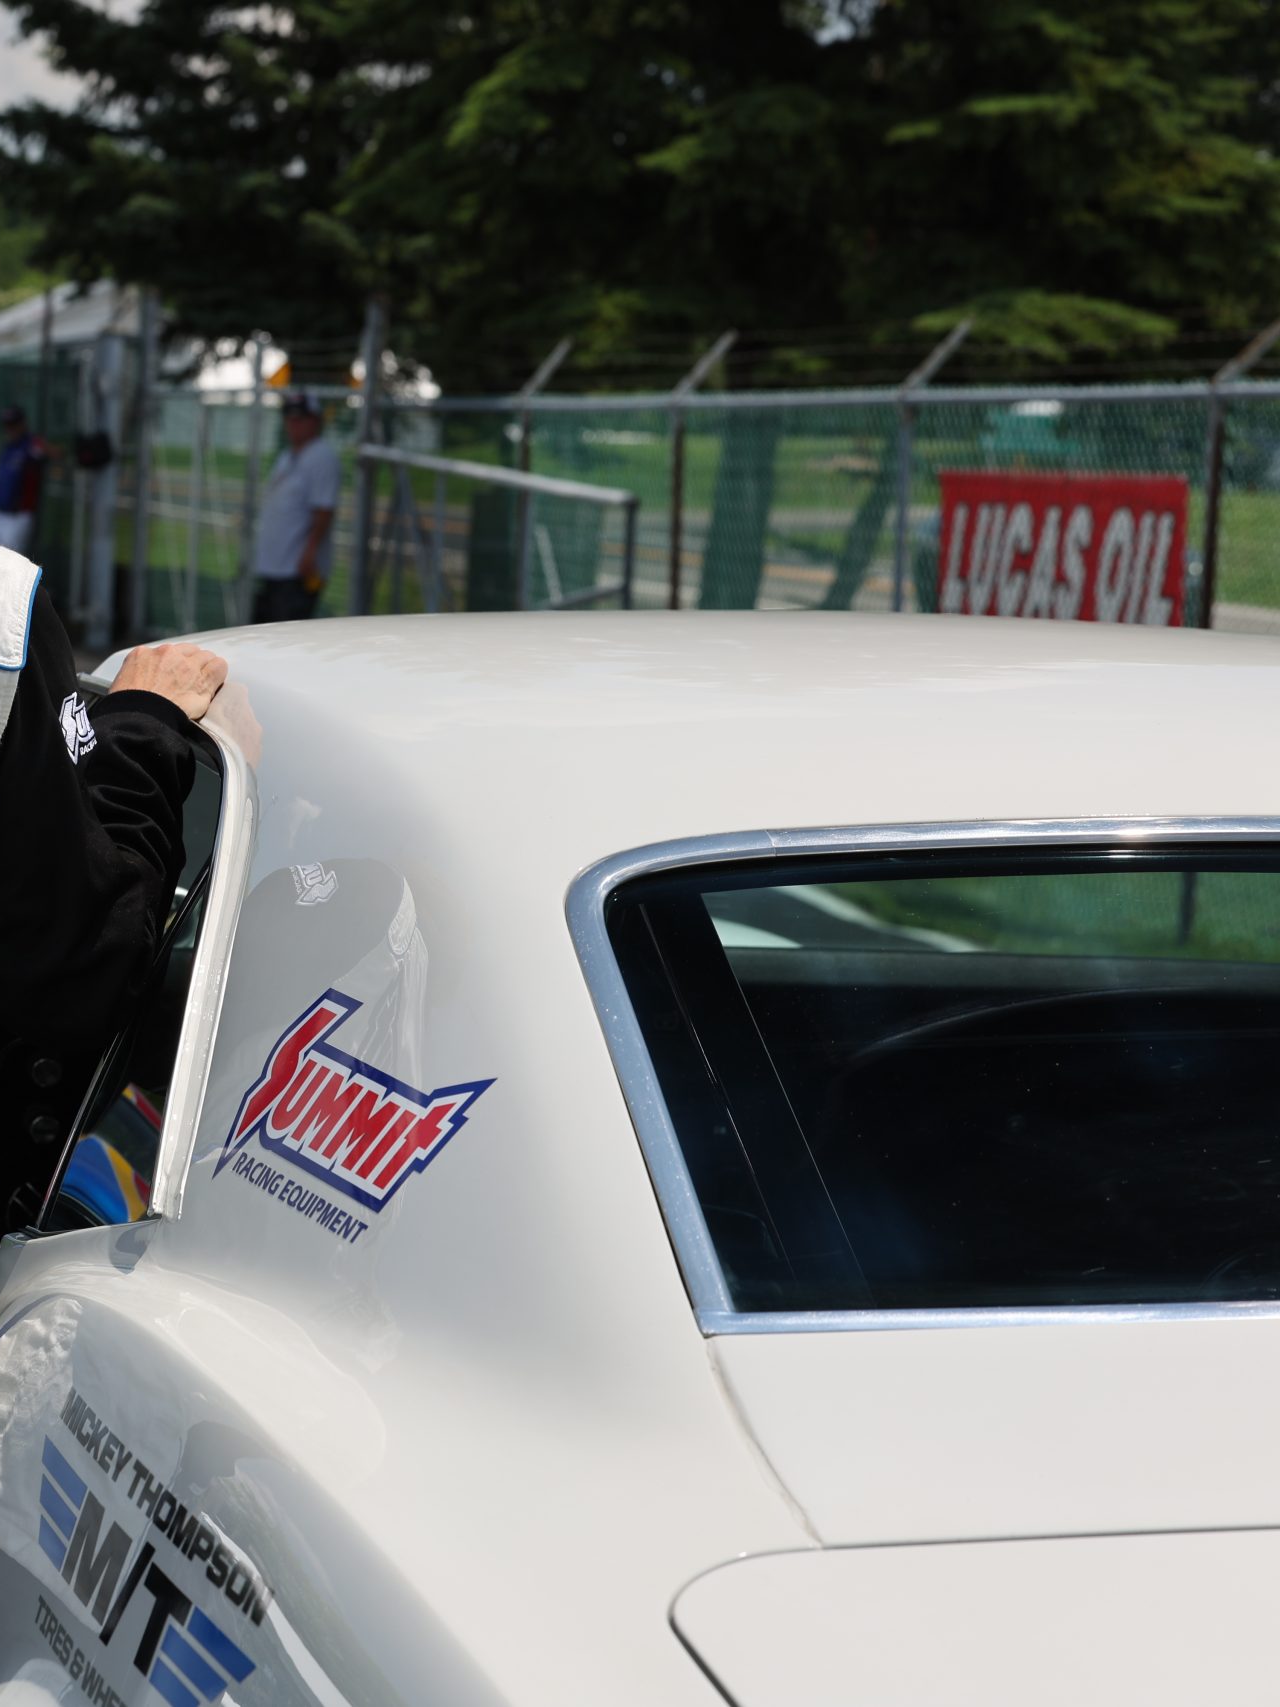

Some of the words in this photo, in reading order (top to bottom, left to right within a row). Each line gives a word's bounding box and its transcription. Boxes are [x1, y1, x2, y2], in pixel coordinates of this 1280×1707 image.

[940, 502, 1093, 619] LUCAS
[1096, 506, 1176, 626] OIL
[232, 1151, 280, 1194] RACING
[278, 1180, 369, 1244] EQUIPMENT
[60, 1386, 133, 1482] MICKEY
[127, 1459, 271, 1627] THOMPSON
[35, 1594, 74, 1667] TIRES
[81, 1661, 128, 1707] WHE
